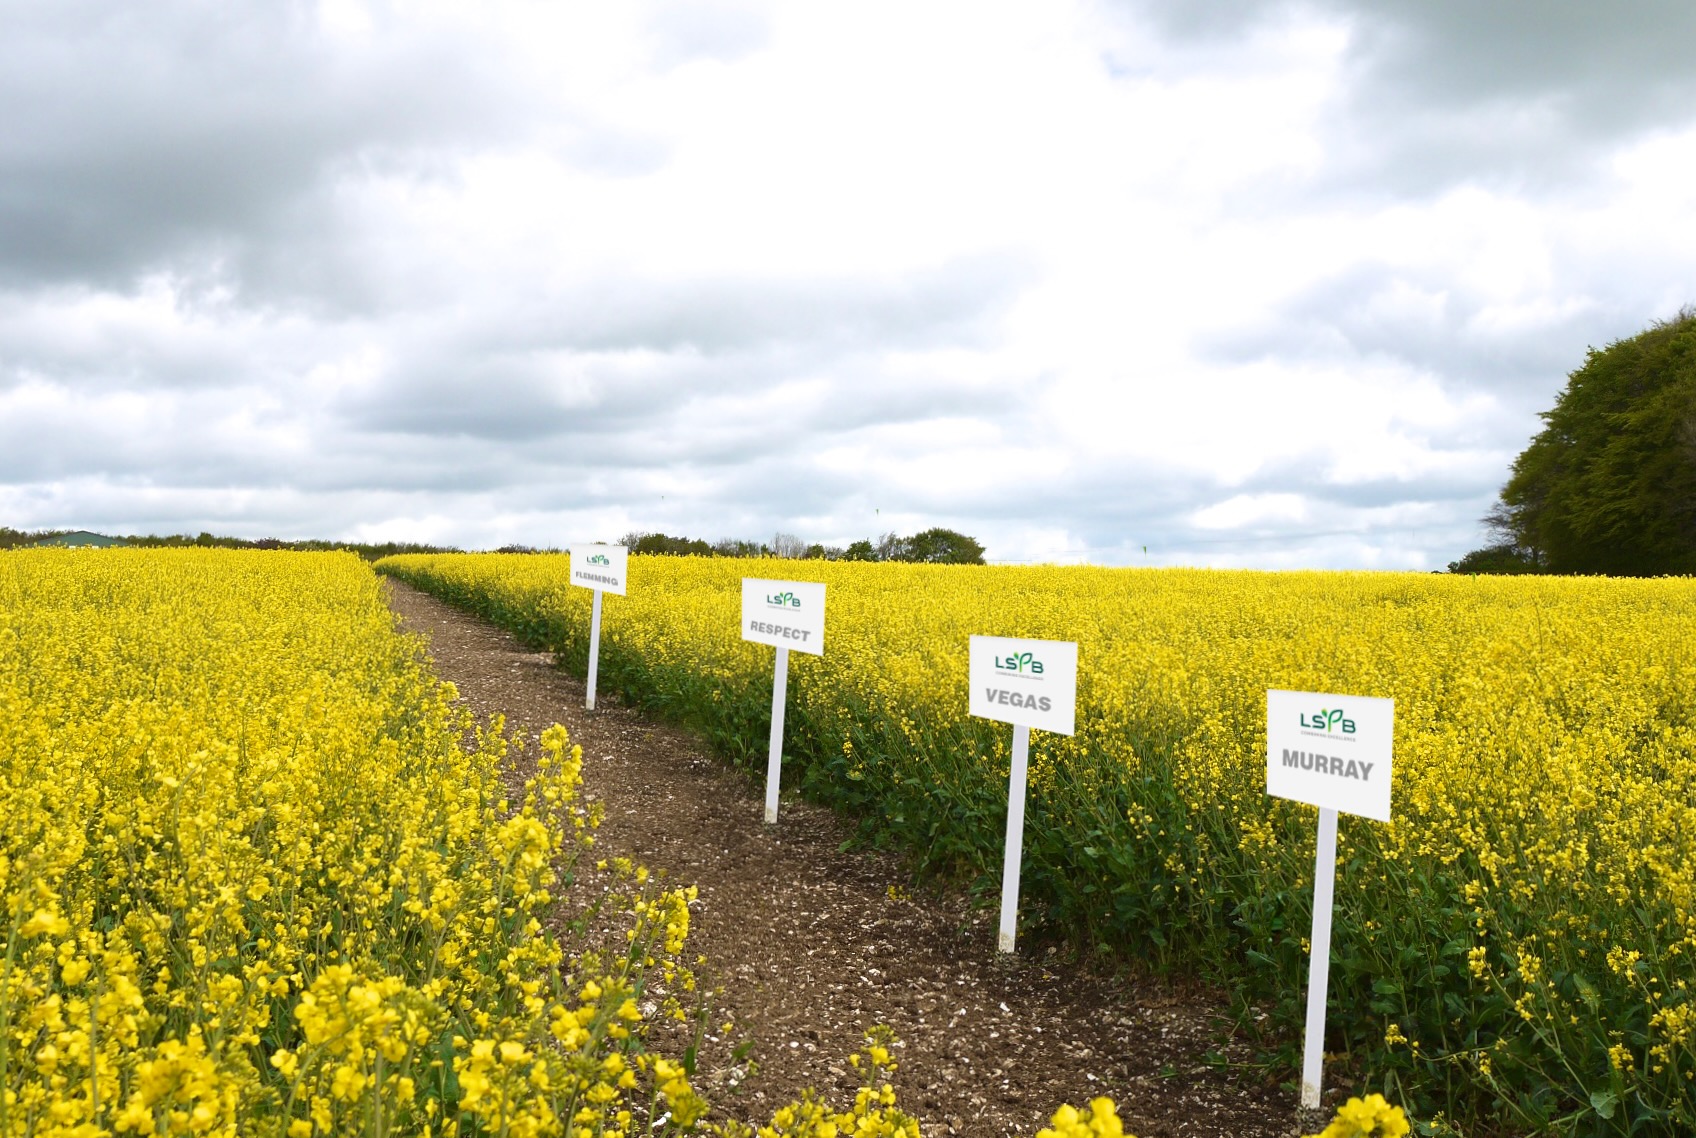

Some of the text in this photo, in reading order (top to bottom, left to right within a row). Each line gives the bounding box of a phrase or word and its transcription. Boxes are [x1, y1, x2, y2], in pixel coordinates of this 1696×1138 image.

[587, 555, 609, 565] LSPB
[575, 571, 619, 586] FLEMMING
[767, 592, 801, 607] LSPB
[750, 621, 811, 642] RESPECT
[995, 652, 1044, 674] LSPB
[986, 688, 1052, 712] VEGAS
[1300, 708, 1356, 734] LSPB
[1282, 748, 1374, 781] MURRAY
